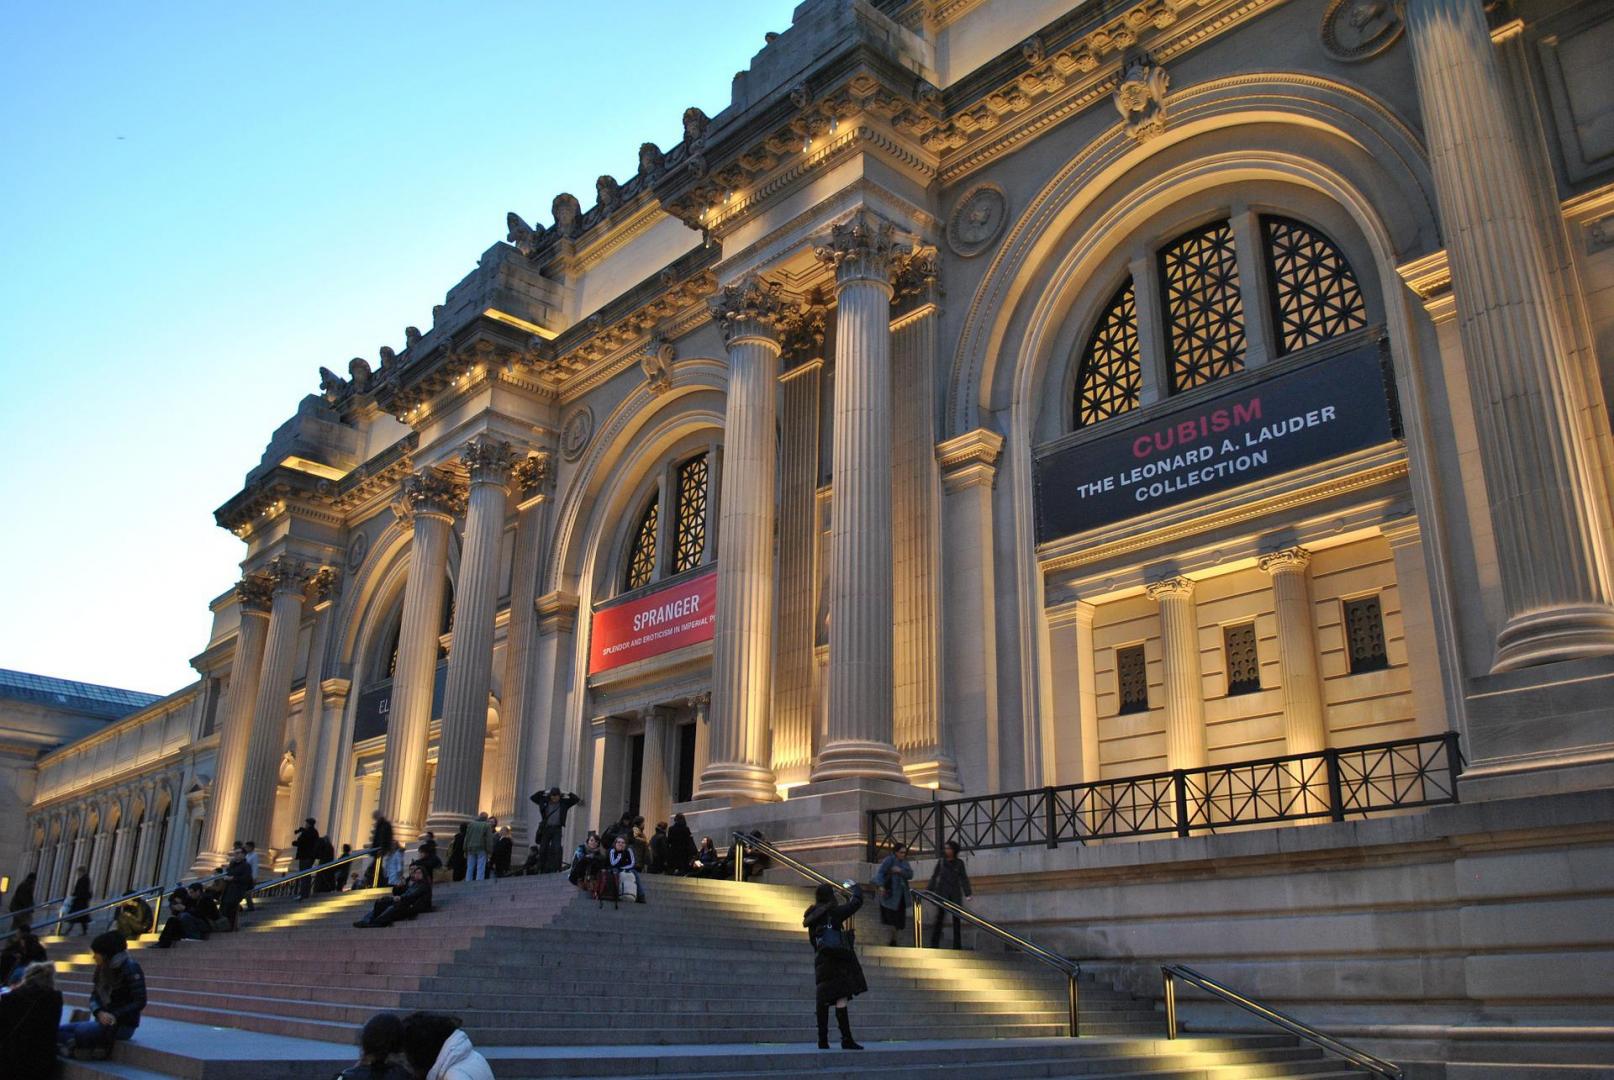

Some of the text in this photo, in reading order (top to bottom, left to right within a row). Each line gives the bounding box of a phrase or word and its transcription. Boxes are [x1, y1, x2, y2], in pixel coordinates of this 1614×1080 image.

[1132, 398, 1263, 458] CUBISM
[1077, 405, 1336, 499] THE LEONARD A. LAUDER
[1134, 449, 1268, 502] COLLECTION
[633, 594, 700, 632] SPRANGER
[602, 641, 631, 656] SPLENDOR
[630, 639, 642, 649] AND
[642, 628, 674, 644] EROTICISM
[673, 625, 681, 634] IN
[681, 618, 709, 632] IMPERIAL
[378, 699, 389, 714] EL
